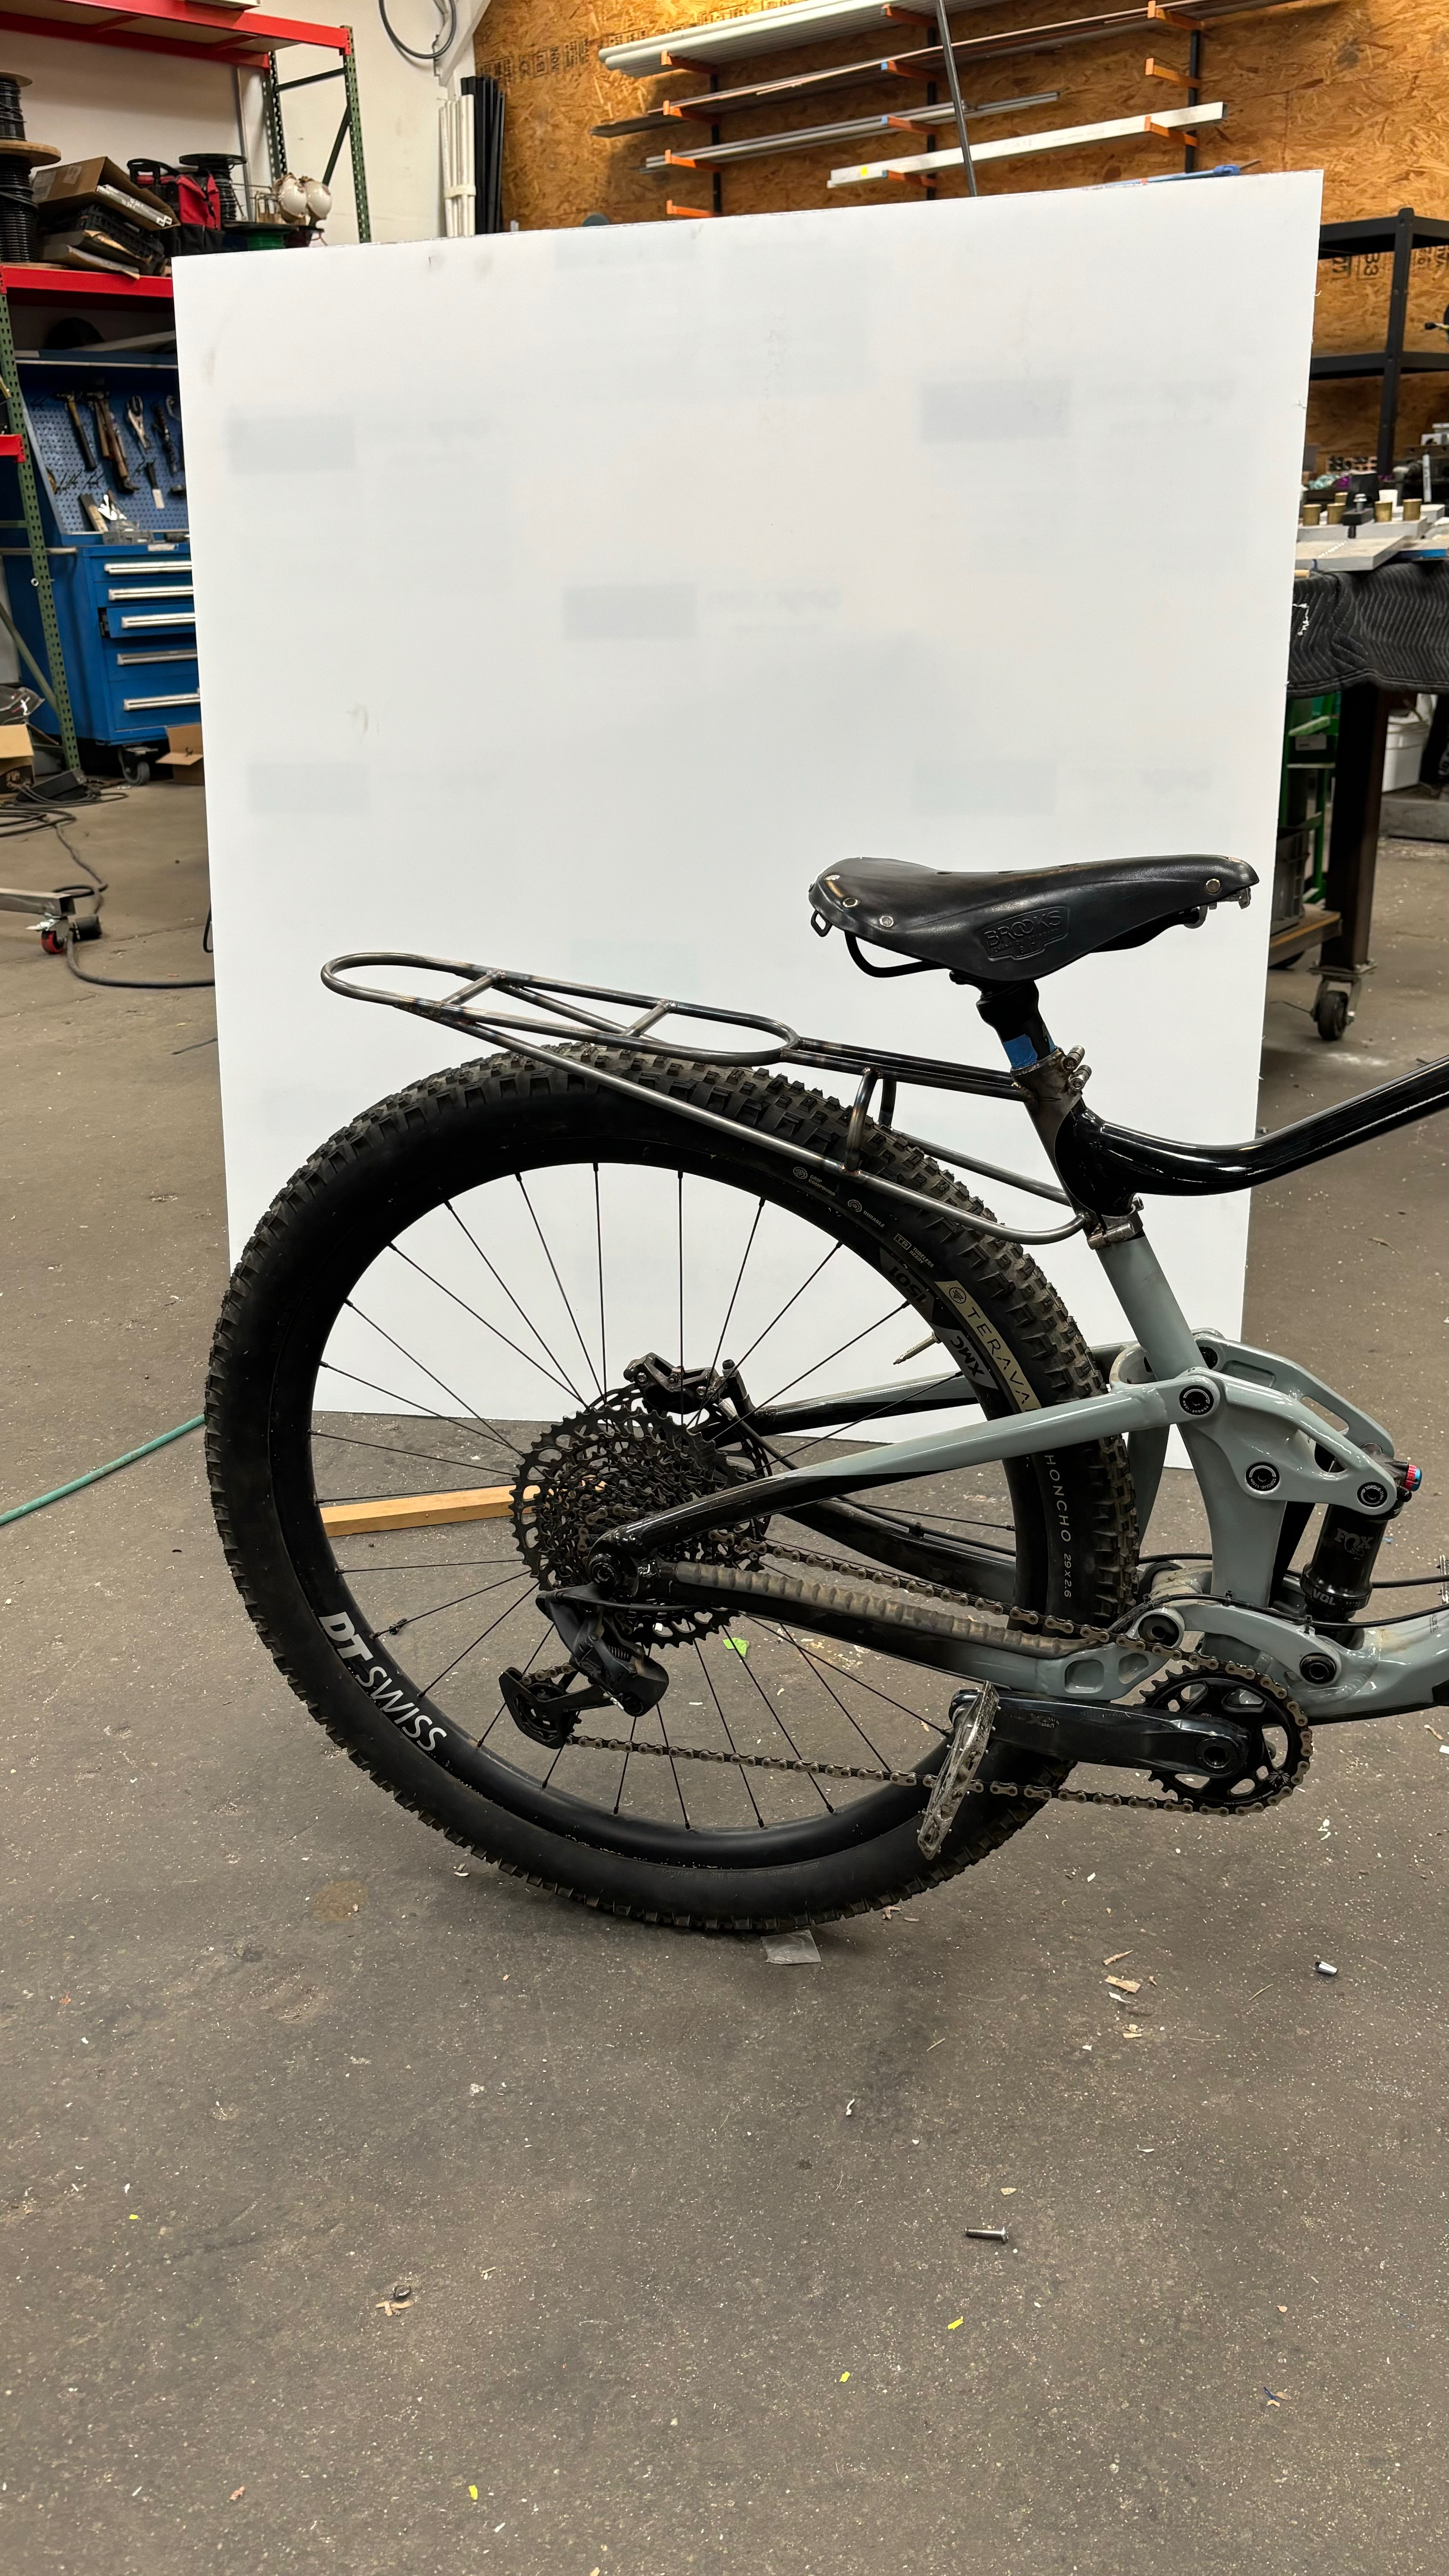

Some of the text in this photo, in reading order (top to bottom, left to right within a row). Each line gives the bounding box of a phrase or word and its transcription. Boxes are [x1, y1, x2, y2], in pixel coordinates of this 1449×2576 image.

[984, 910, 1062, 948] BROOKS
[808, 1178, 836, 1196] COMPOUND
[810, 1174, 823, 1183] GRIP
[863, 1210, 885, 1228] DURABLE
[896, 1234, 910, 1249] TR
[909, 1250, 925, 1264] READY
[913, 1246, 935, 1268] TUBELESS
[949, 1335, 985, 1377] XMC
[1044, 1454, 1071, 1542] HONCHO
[1334, 1527, 1375, 1557] FOX
[318, 1611, 447, 1751] DT SWISS
